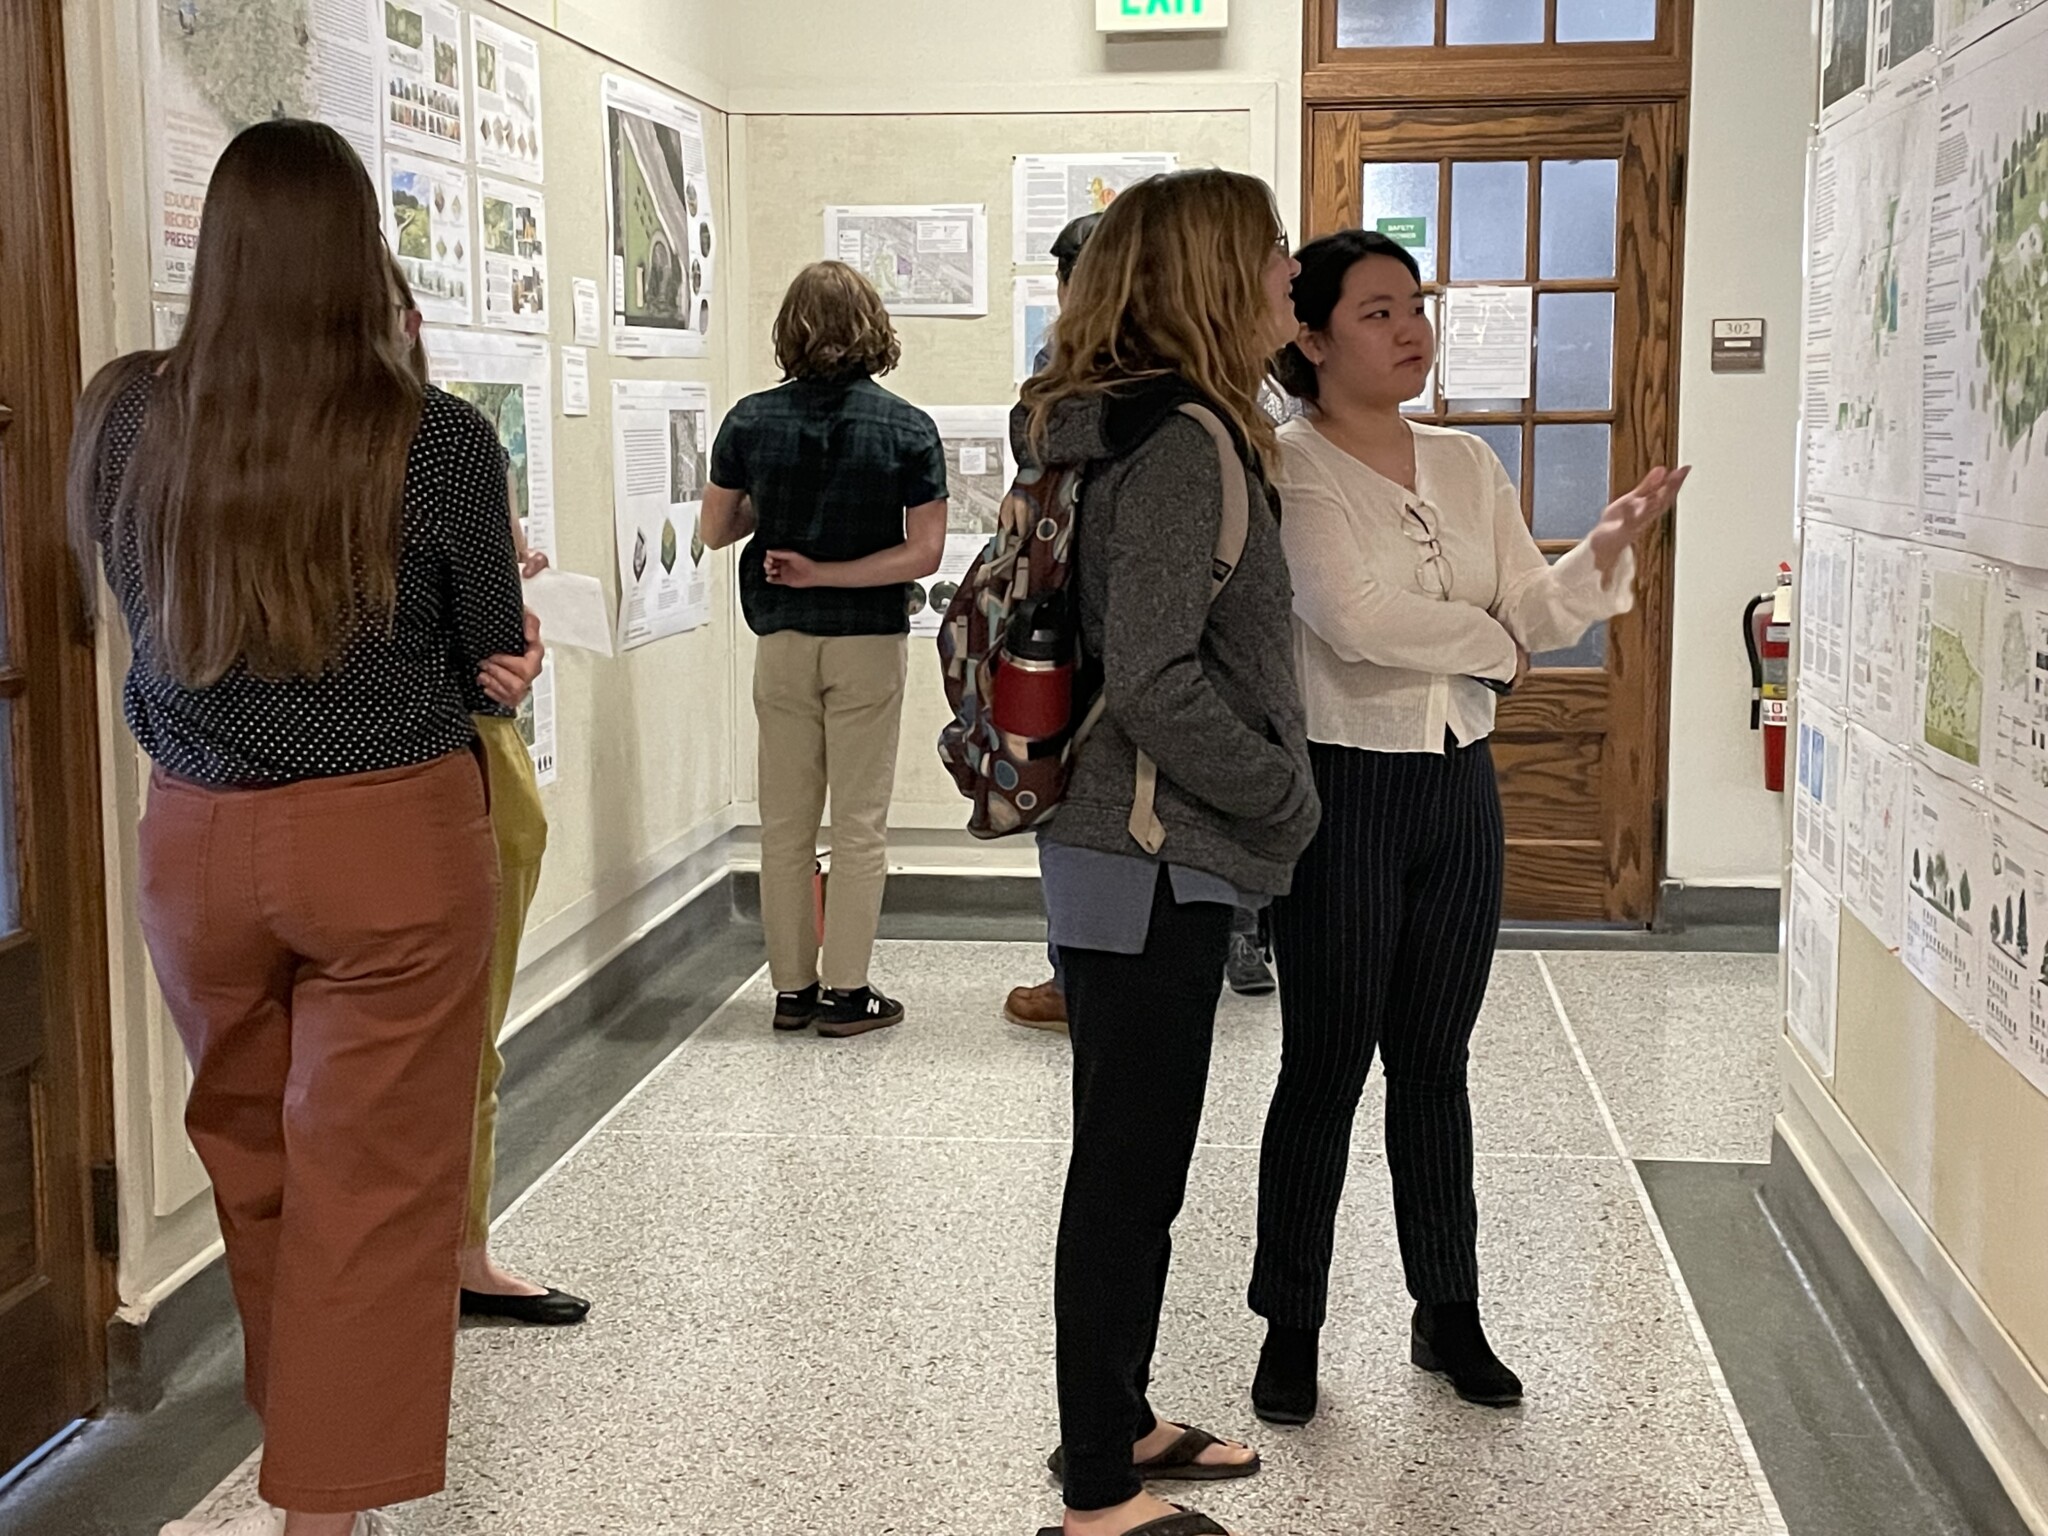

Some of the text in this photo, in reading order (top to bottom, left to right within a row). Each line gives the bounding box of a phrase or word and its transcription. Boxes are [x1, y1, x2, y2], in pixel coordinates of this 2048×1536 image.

[1388, 224, 1415, 232] SAFETY
[1726, 323, 1750, 335] 302
[867, 998, 879, 1014] N
